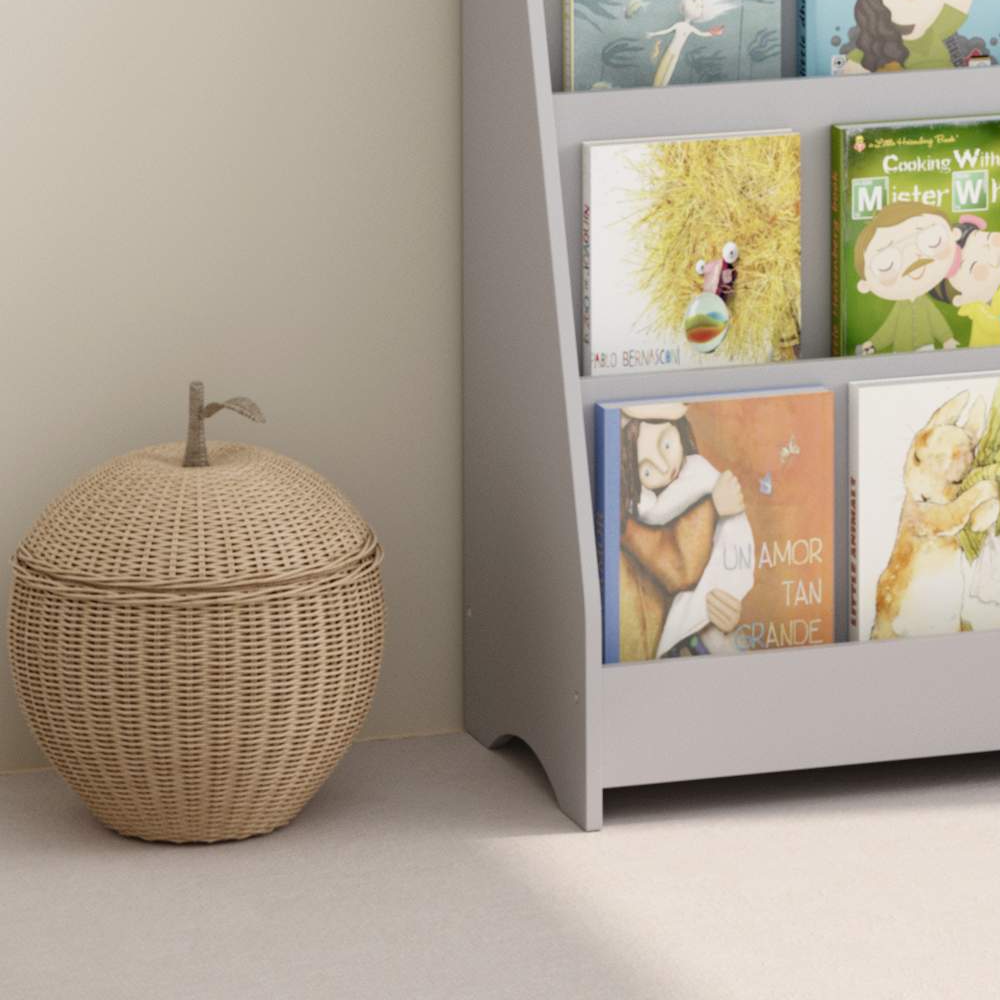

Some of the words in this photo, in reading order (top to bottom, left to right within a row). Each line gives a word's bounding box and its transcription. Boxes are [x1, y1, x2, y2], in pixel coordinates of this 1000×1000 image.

[882, 153, 952, 174] Cooking
[953, 147, 1000, 169] With
[831, 171, 839, 213] book
[622, 347, 681, 368] BERNASCONI
[722, 543, 752, 571] UN
[758, 537, 823, 570] AMOR
[781, 577, 823, 607] TAN
[734, 619, 823, 652] GRANDE
